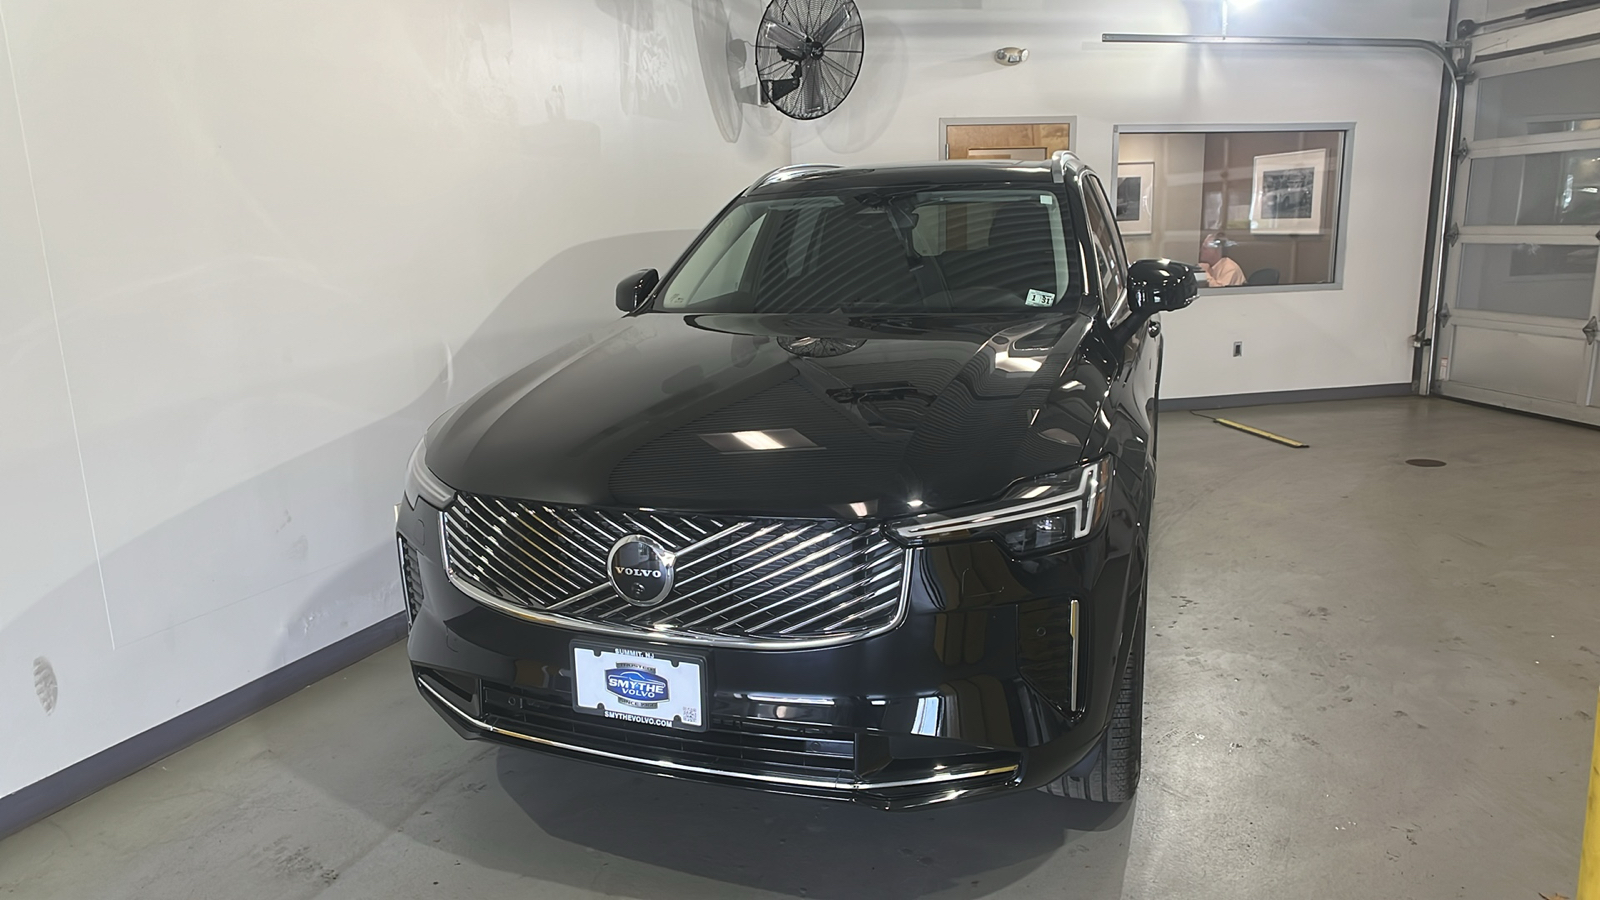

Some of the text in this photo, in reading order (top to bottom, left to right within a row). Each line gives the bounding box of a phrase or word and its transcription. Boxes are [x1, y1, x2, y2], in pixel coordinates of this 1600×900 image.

[615, 566, 662, 578] VOLVO
[608, 678, 664, 694] SMYTHE
[622, 688, 655, 698] VOLVO
[604, 710, 673, 727] SMYTHEVOLVO.COM
